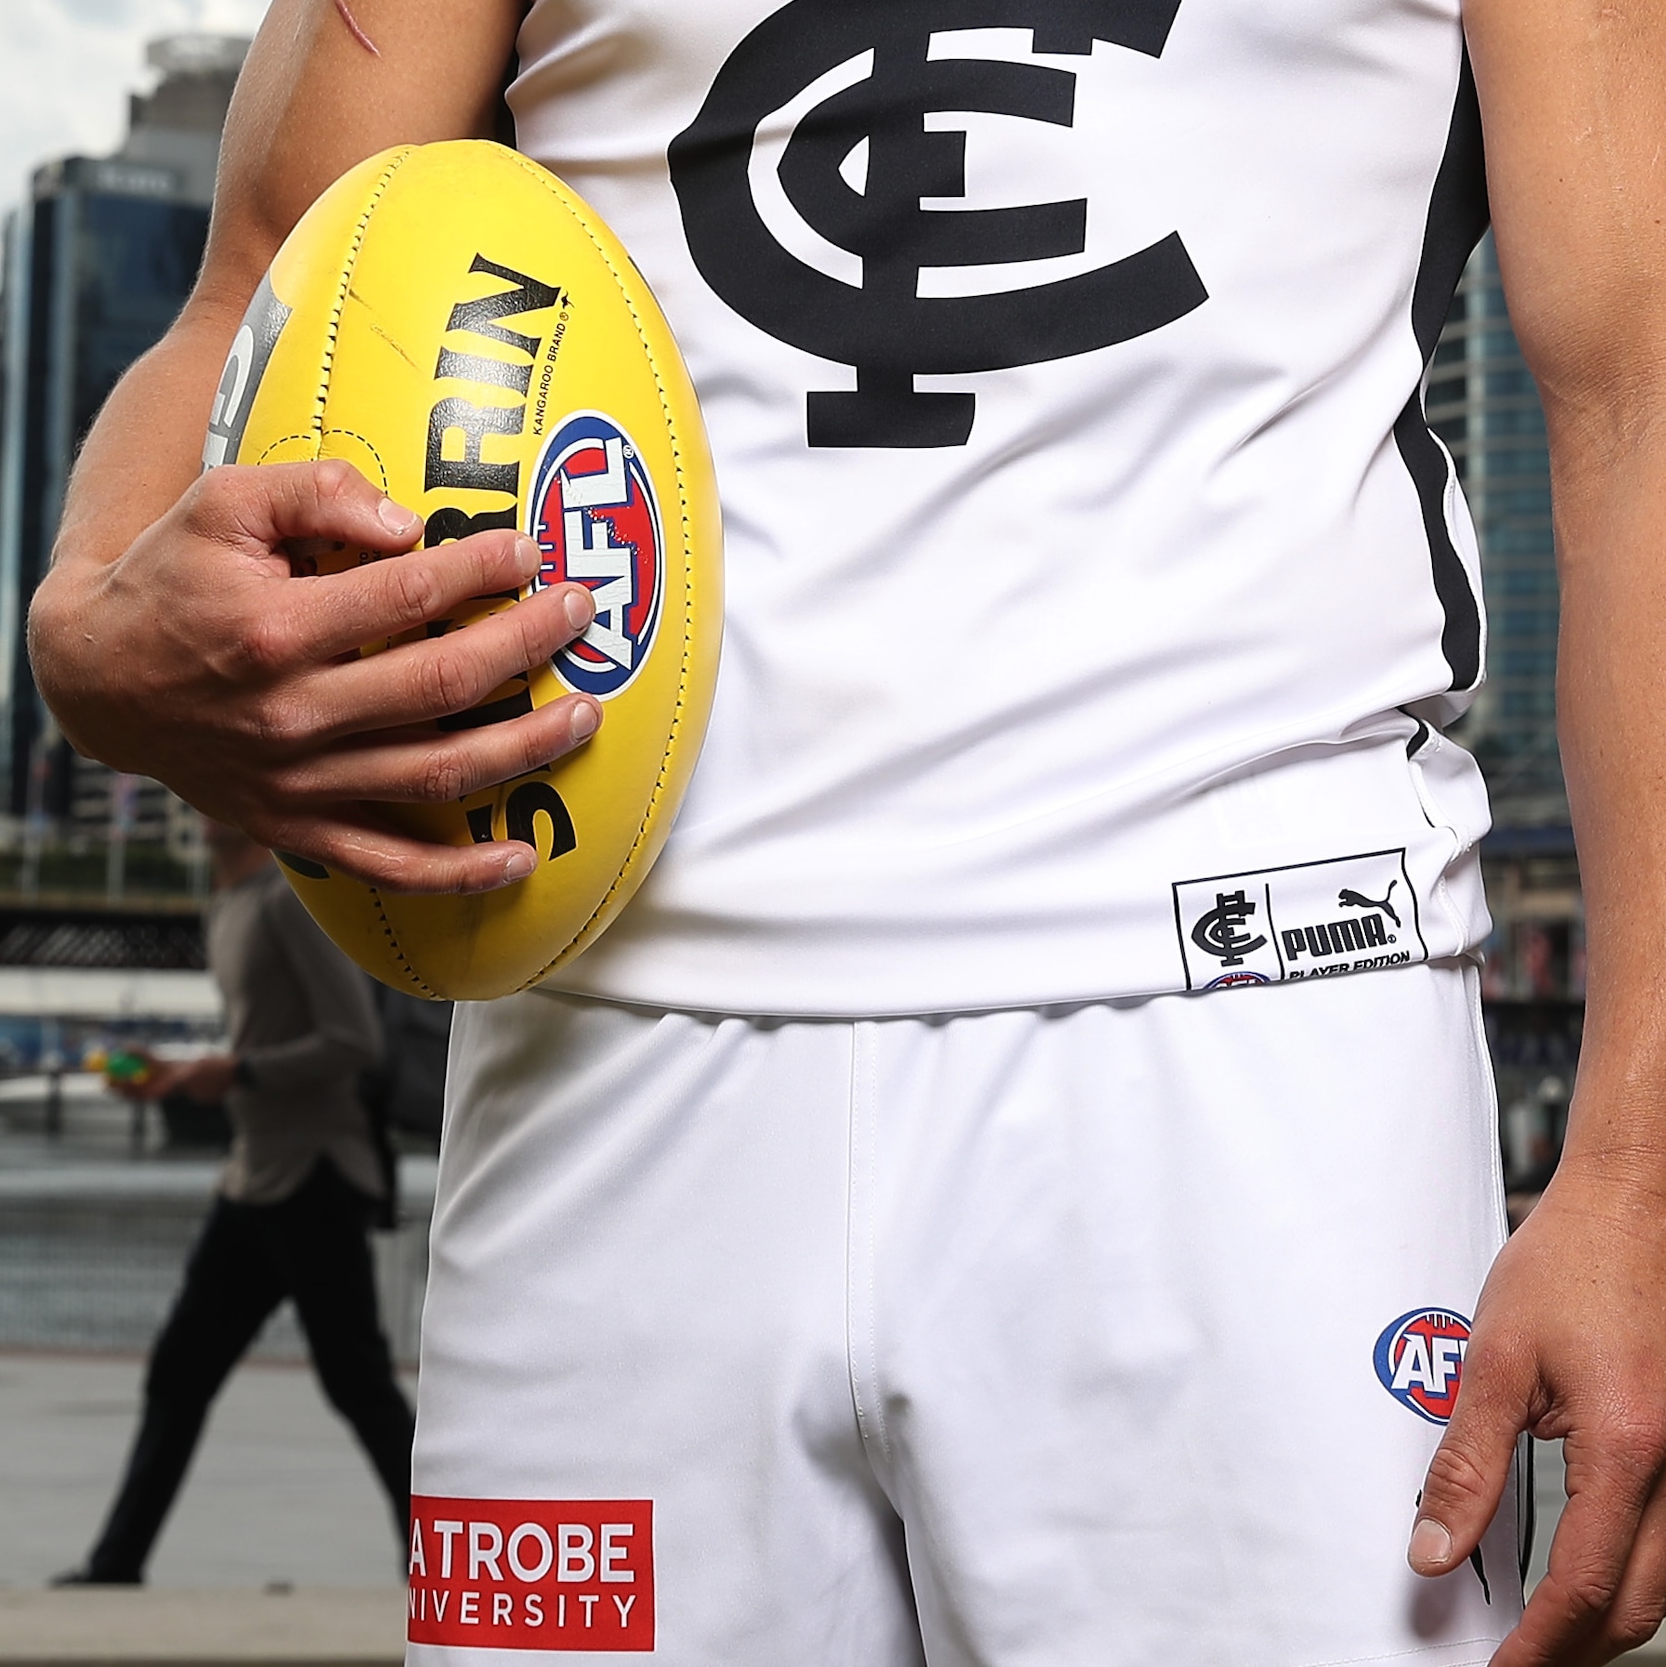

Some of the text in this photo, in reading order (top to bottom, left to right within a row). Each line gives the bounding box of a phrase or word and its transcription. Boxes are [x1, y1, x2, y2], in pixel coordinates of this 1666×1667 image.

[533, 322, 566, 436] KANGAROO BRAND
[559, 437, 632, 671] AFL
[1281, 913, 1387, 961] PUMA
[1353, 950, 1411, 971] EDITION
[1391, 1333, 1469, 1394] AF
[433, 1520, 635, 1583] TROBE
[409, 1587, 637, 1629] NIVERSITY
